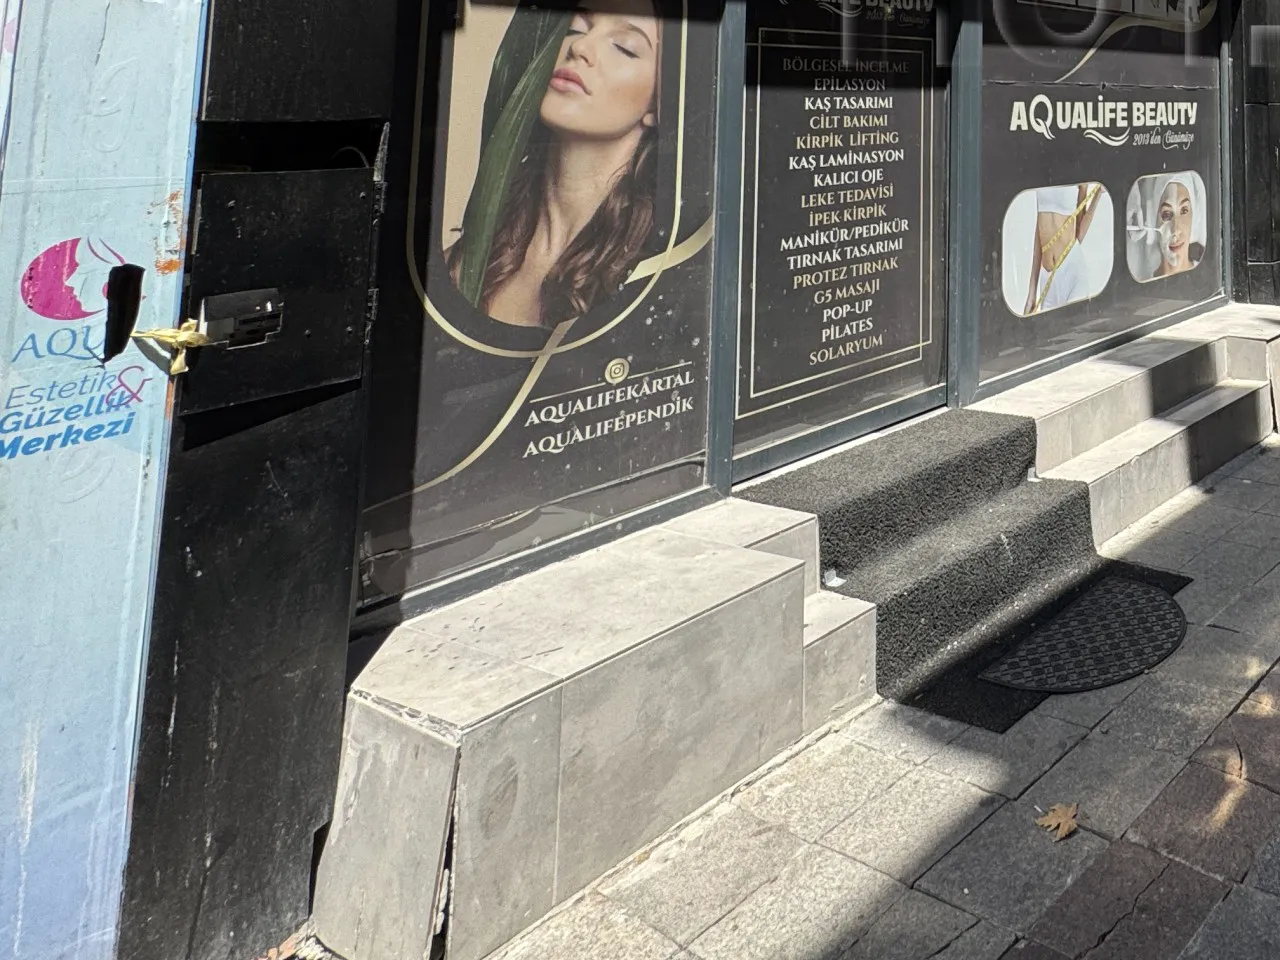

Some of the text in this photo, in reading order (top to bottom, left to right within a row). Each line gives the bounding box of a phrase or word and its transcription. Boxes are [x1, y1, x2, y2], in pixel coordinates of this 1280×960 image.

[783, 56, 852, 72] BÖLGESEL
[814, 75, 886, 91] EPİLASYON
[804, 96, 893, 113] KAŞ TASARIMI
[1132, 101, 1198, 127] BEAUTY
[810, 113, 888, 130] CİLT BAKIMI
[796, 131, 899, 150] KİRPİK LİFTİNG
[789, 149, 905, 171] KAŞ LAMİNASYON
[813, 168, 884, 187] KALICI OJE
[801, 183, 894, 209] LEKE TEDAVİSİ
[809, 204, 887, 227] İPEK KİRPİK
[787, 237, 903, 270] TIRNAK TASARIMI
[793, 257, 899, 290] PROTEZ TIRNAK
[814, 278, 880, 305] G5 MASAJI
[822, 298, 873, 323] POP-UP
[821, 317, 874, 342] PİLATES
[809, 334, 884, 366] SOLARYUM
[5, 372, 118, 410] Estetik
[106, 365, 152, 407] &
[524, 370, 695, 428] AQUALIFEKARTAL
[0, 390, 132, 435] Güzellik
[0, 412, 137, 460] Merkezi
